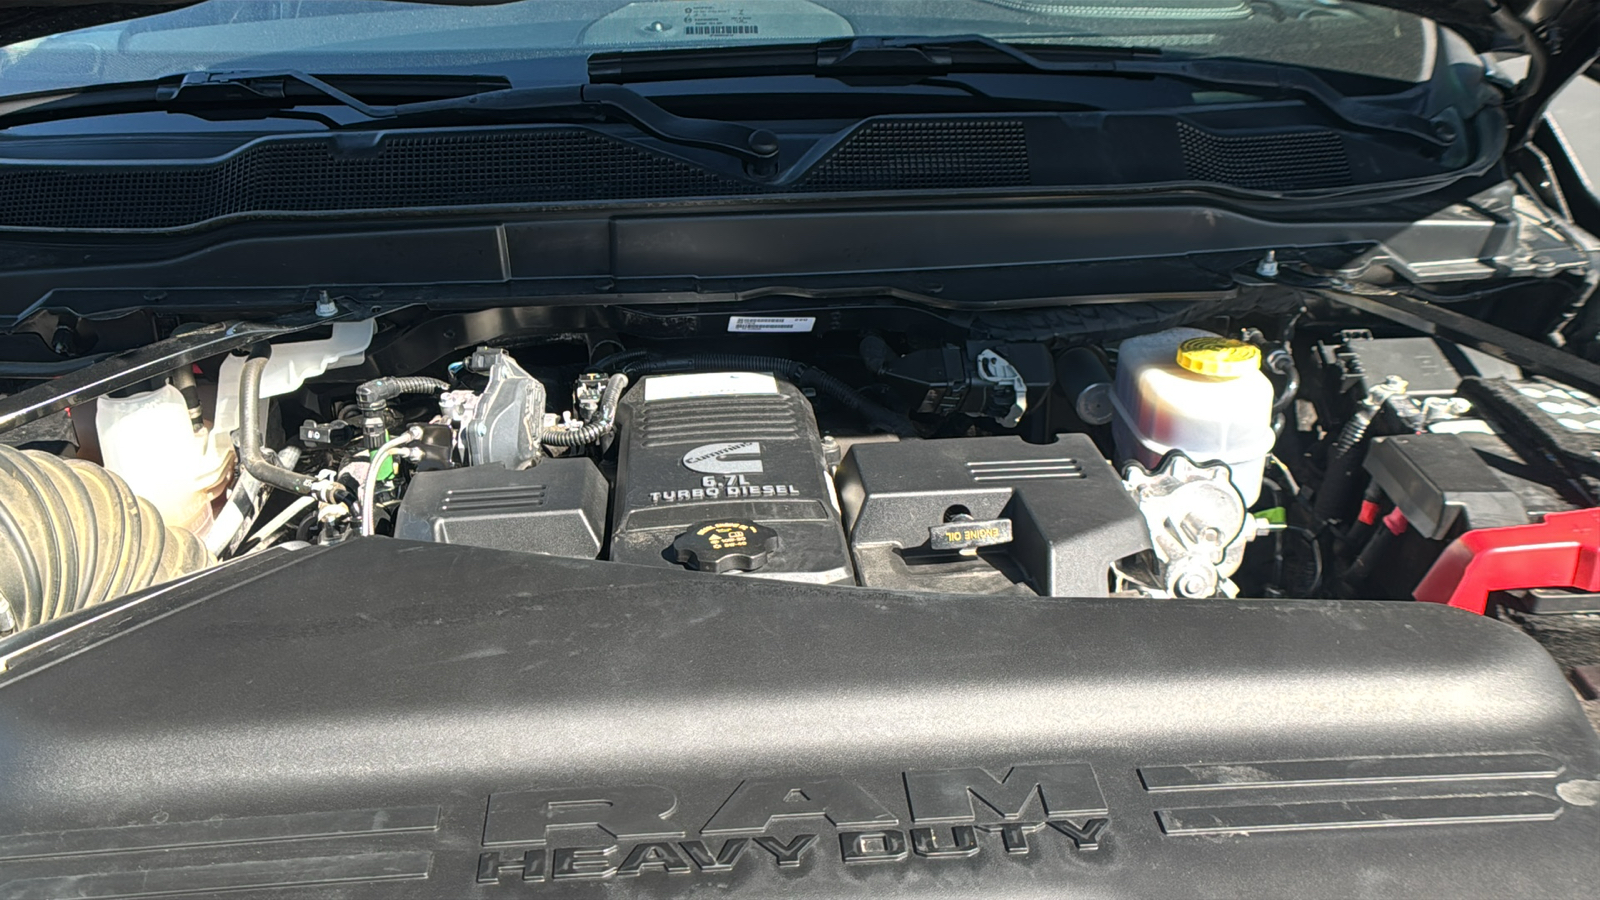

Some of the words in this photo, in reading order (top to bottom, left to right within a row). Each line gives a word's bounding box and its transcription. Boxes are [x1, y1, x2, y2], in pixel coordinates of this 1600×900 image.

[702, 474, 750, 488] 6.7L
[649, 487, 719, 501] TURBO
[727, 484, 799, 497] DIESEL
[946, 532, 962, 542] OIL
[964, 528, 999, 540] ENGINE
[481, 762, 1110, 846] RAM
[476, 834, 820, 883] HEAVY
[838, 817, 1109, 863] DUTY
